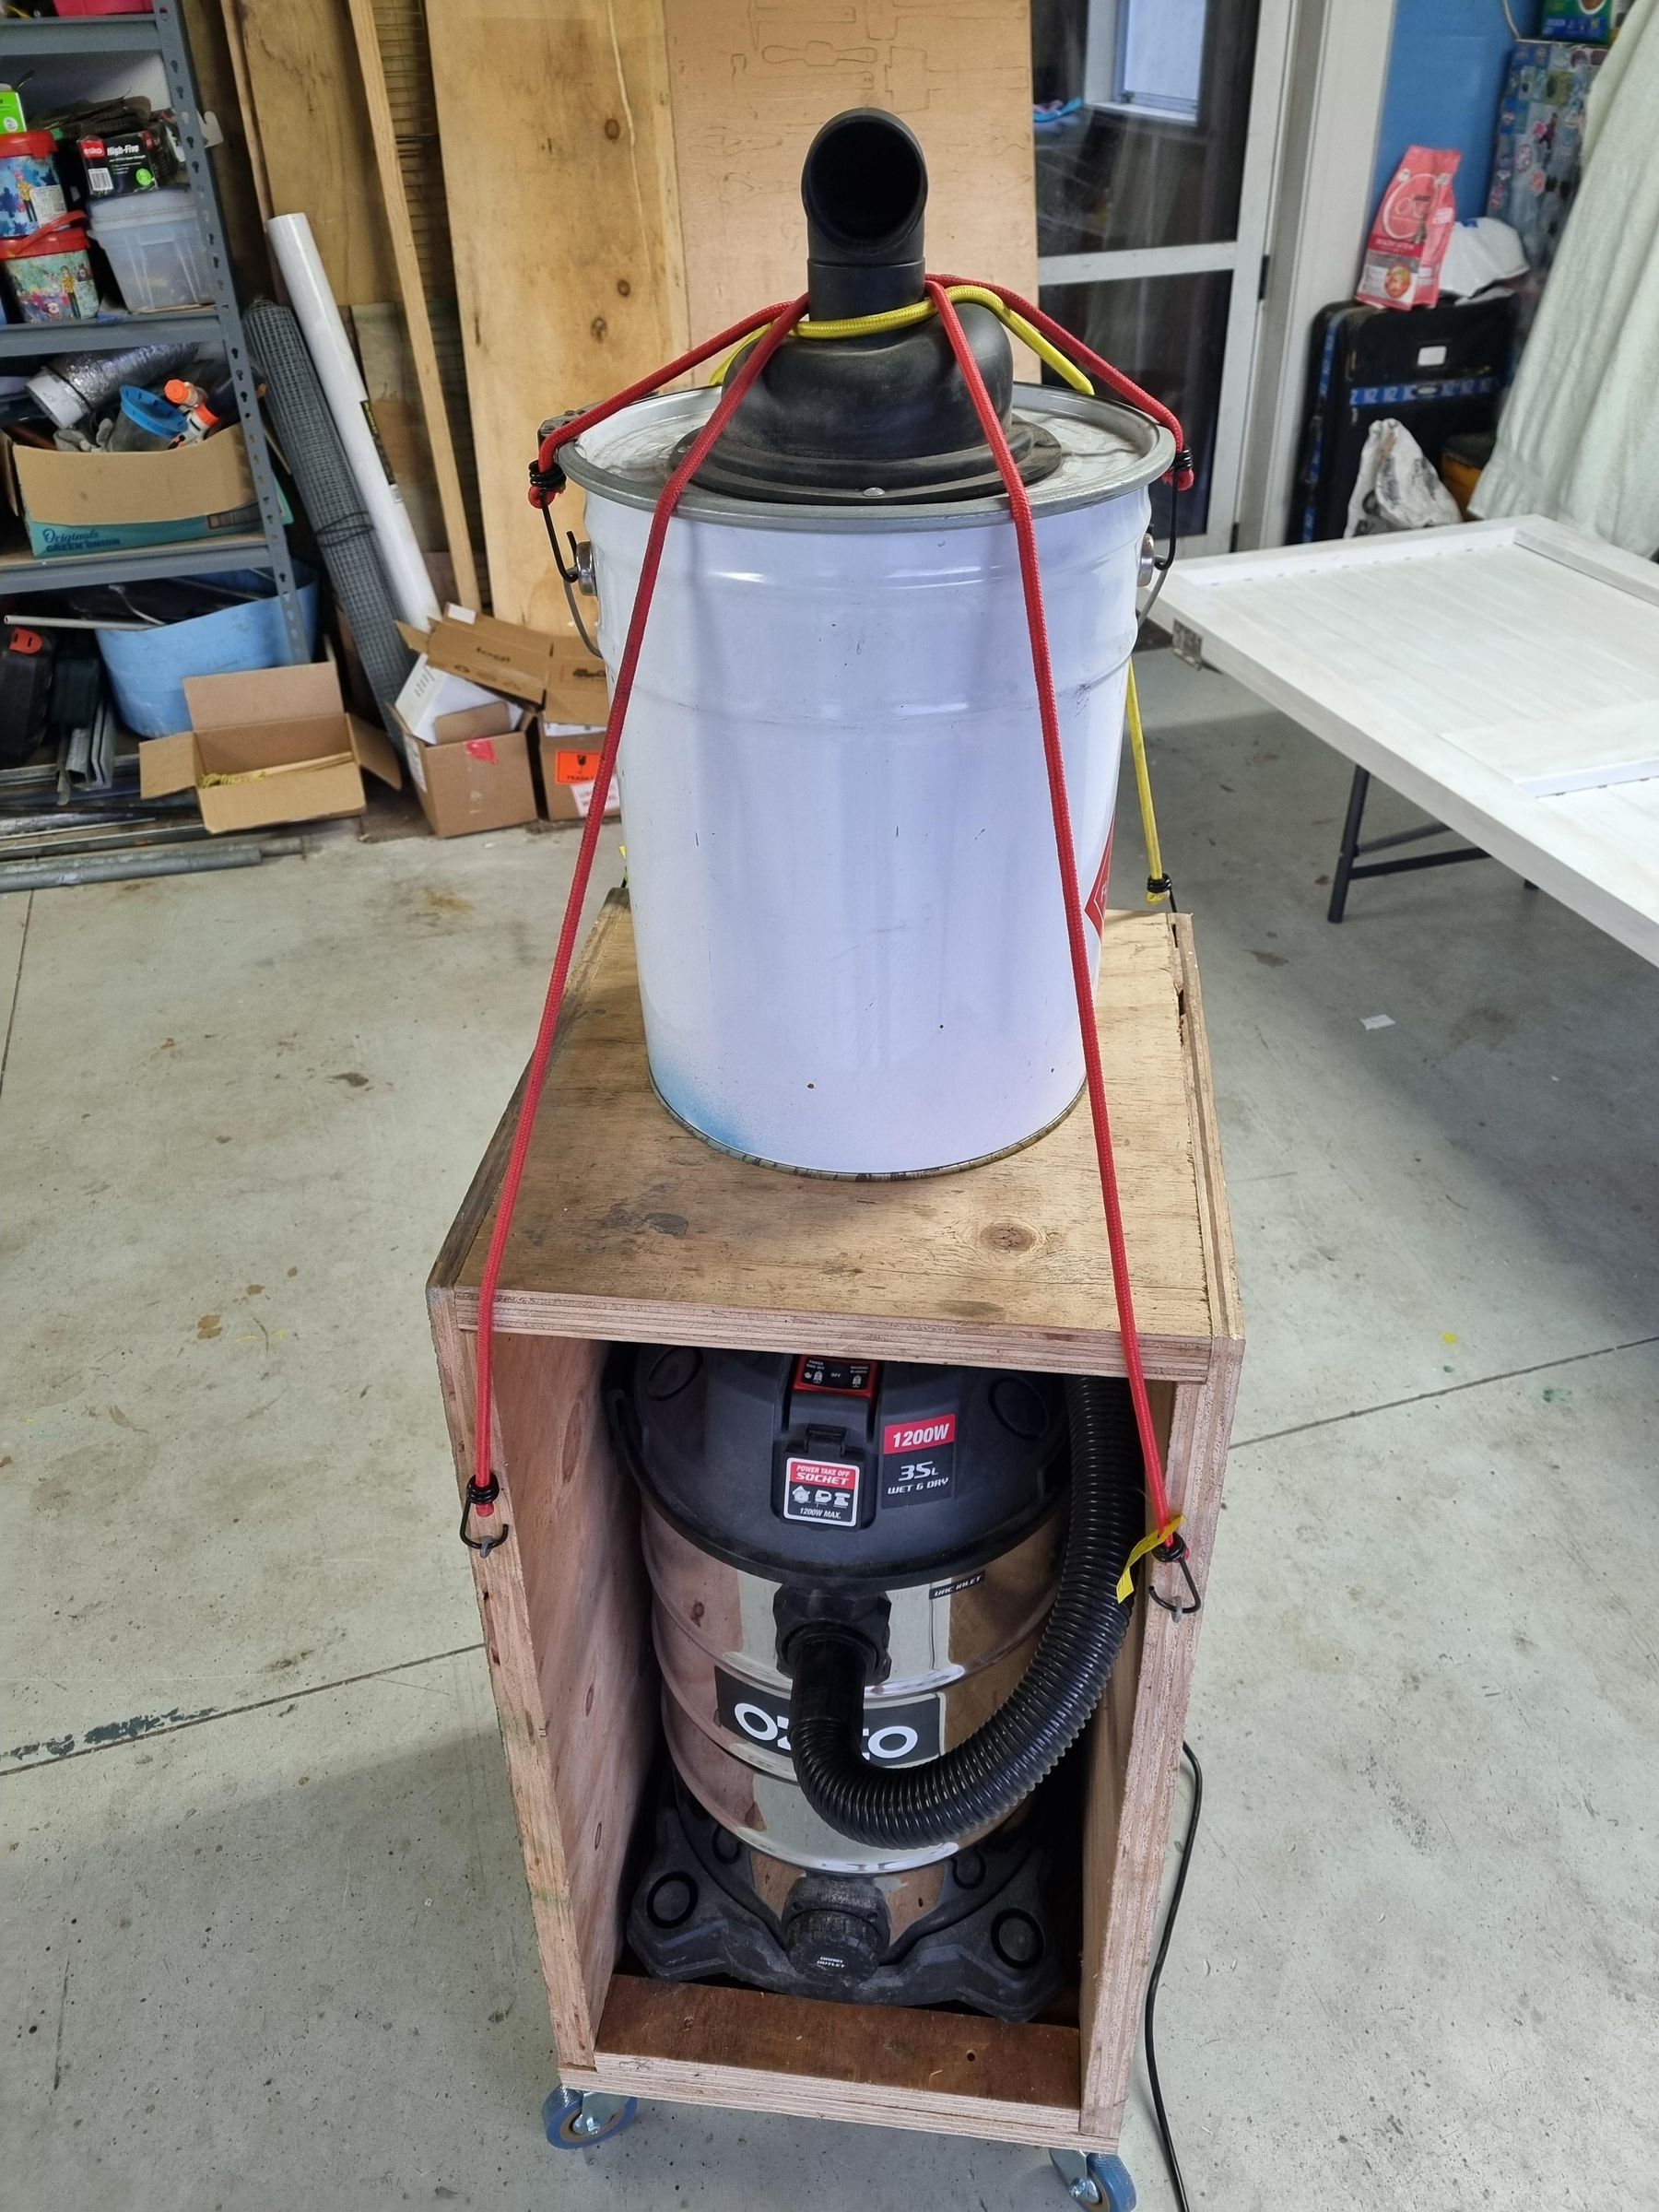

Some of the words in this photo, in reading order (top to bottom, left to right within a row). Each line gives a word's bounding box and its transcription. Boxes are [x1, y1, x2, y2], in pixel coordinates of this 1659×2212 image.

[107, 145, 139, 156] High-Five
[42, 528, 100, 544] Originals
[893, 1422, 950, 1448] 1200W
[796, 1465, 820, 1475] POWER
[820, 1467, 838, 1477] TAKE
[837, 1470, 851, 1478] OFF
[898, 1460, 939, 1482] 35L
[795, 1472, 850, 1486] SOCKET
[887, 1484, 914, 1495] WET
[915, 1482, 924, 1491] &
[926, 1477, 949, 1489] DRY
[800, 1507, 823, 1517] 1200W
[823, 1510, 841, 1520] MAX.
